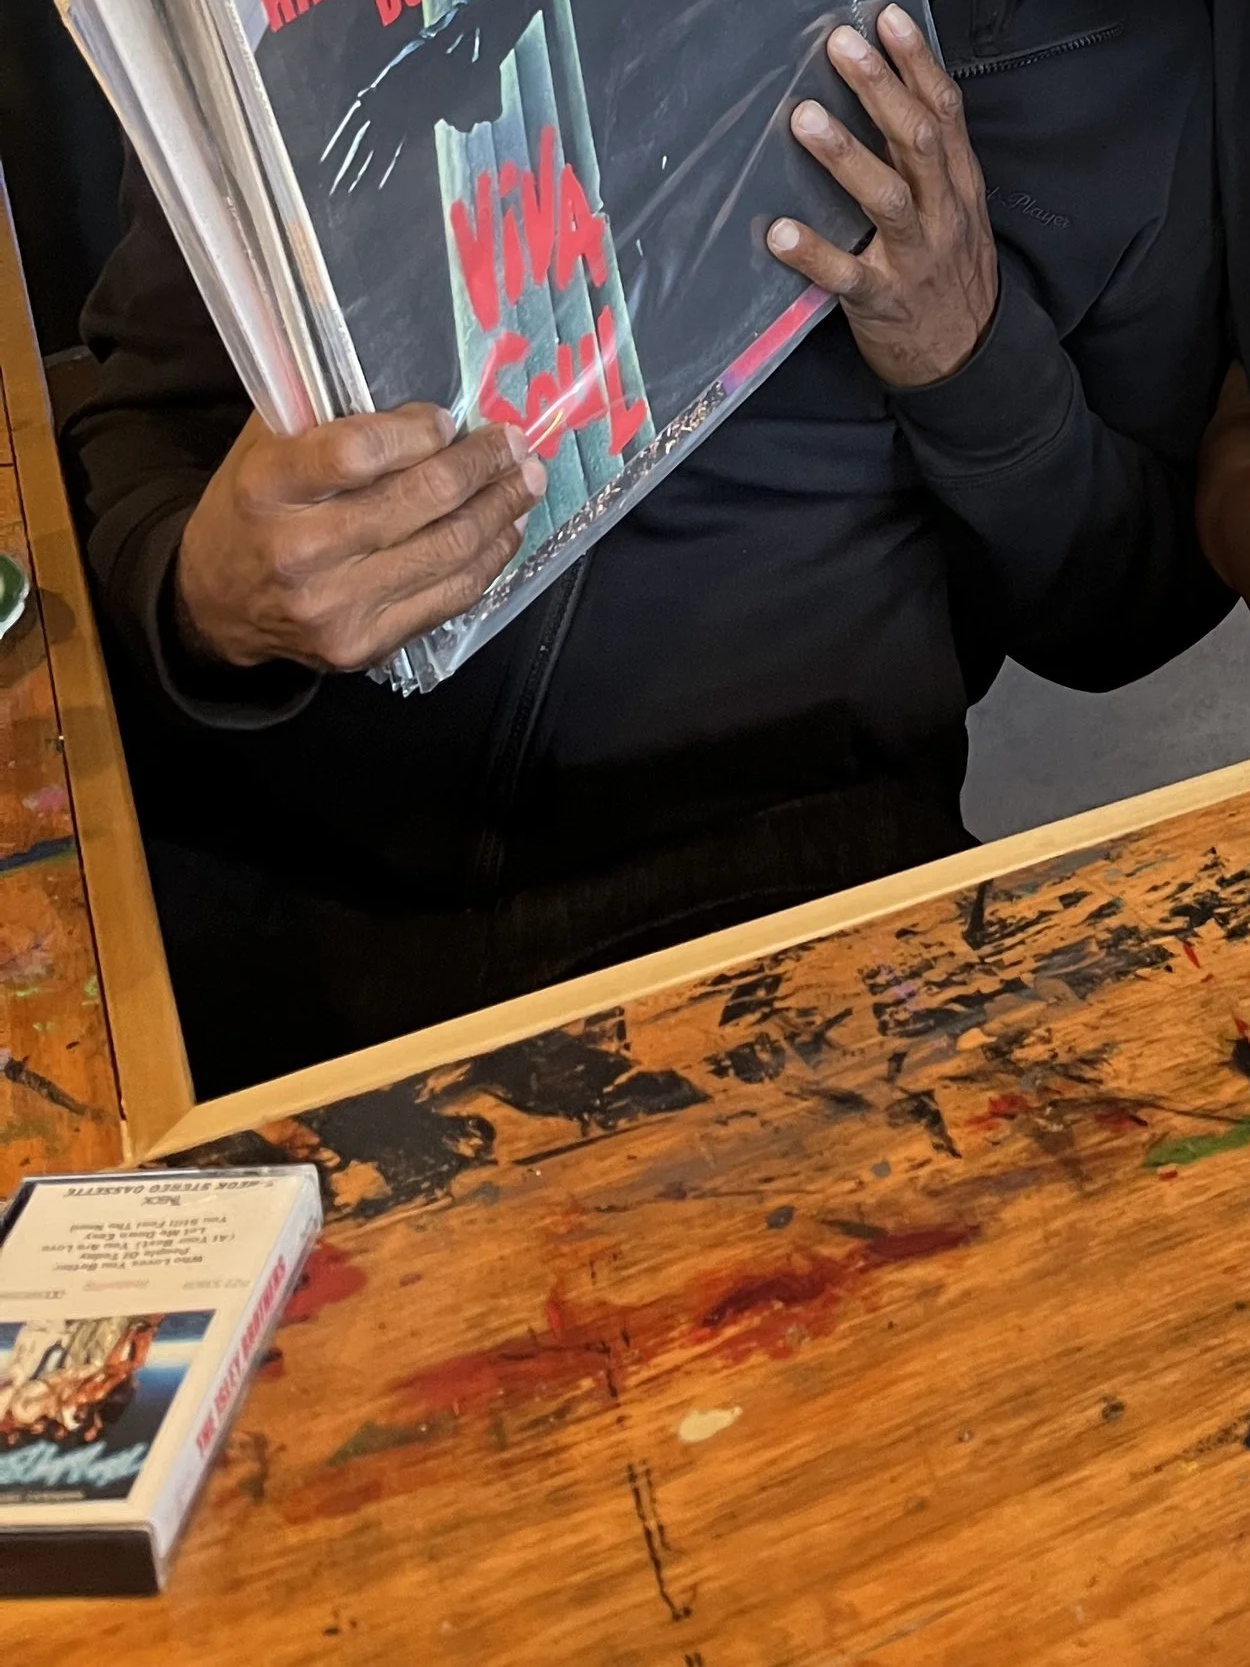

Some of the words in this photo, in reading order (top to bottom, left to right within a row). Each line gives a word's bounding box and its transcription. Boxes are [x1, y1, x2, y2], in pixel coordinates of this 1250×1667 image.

[1002, 191, 1072, 228] Player
[62, 1185, 145, 1198] CASSETTE
[149, 1183, 212, 1194] STEREO
